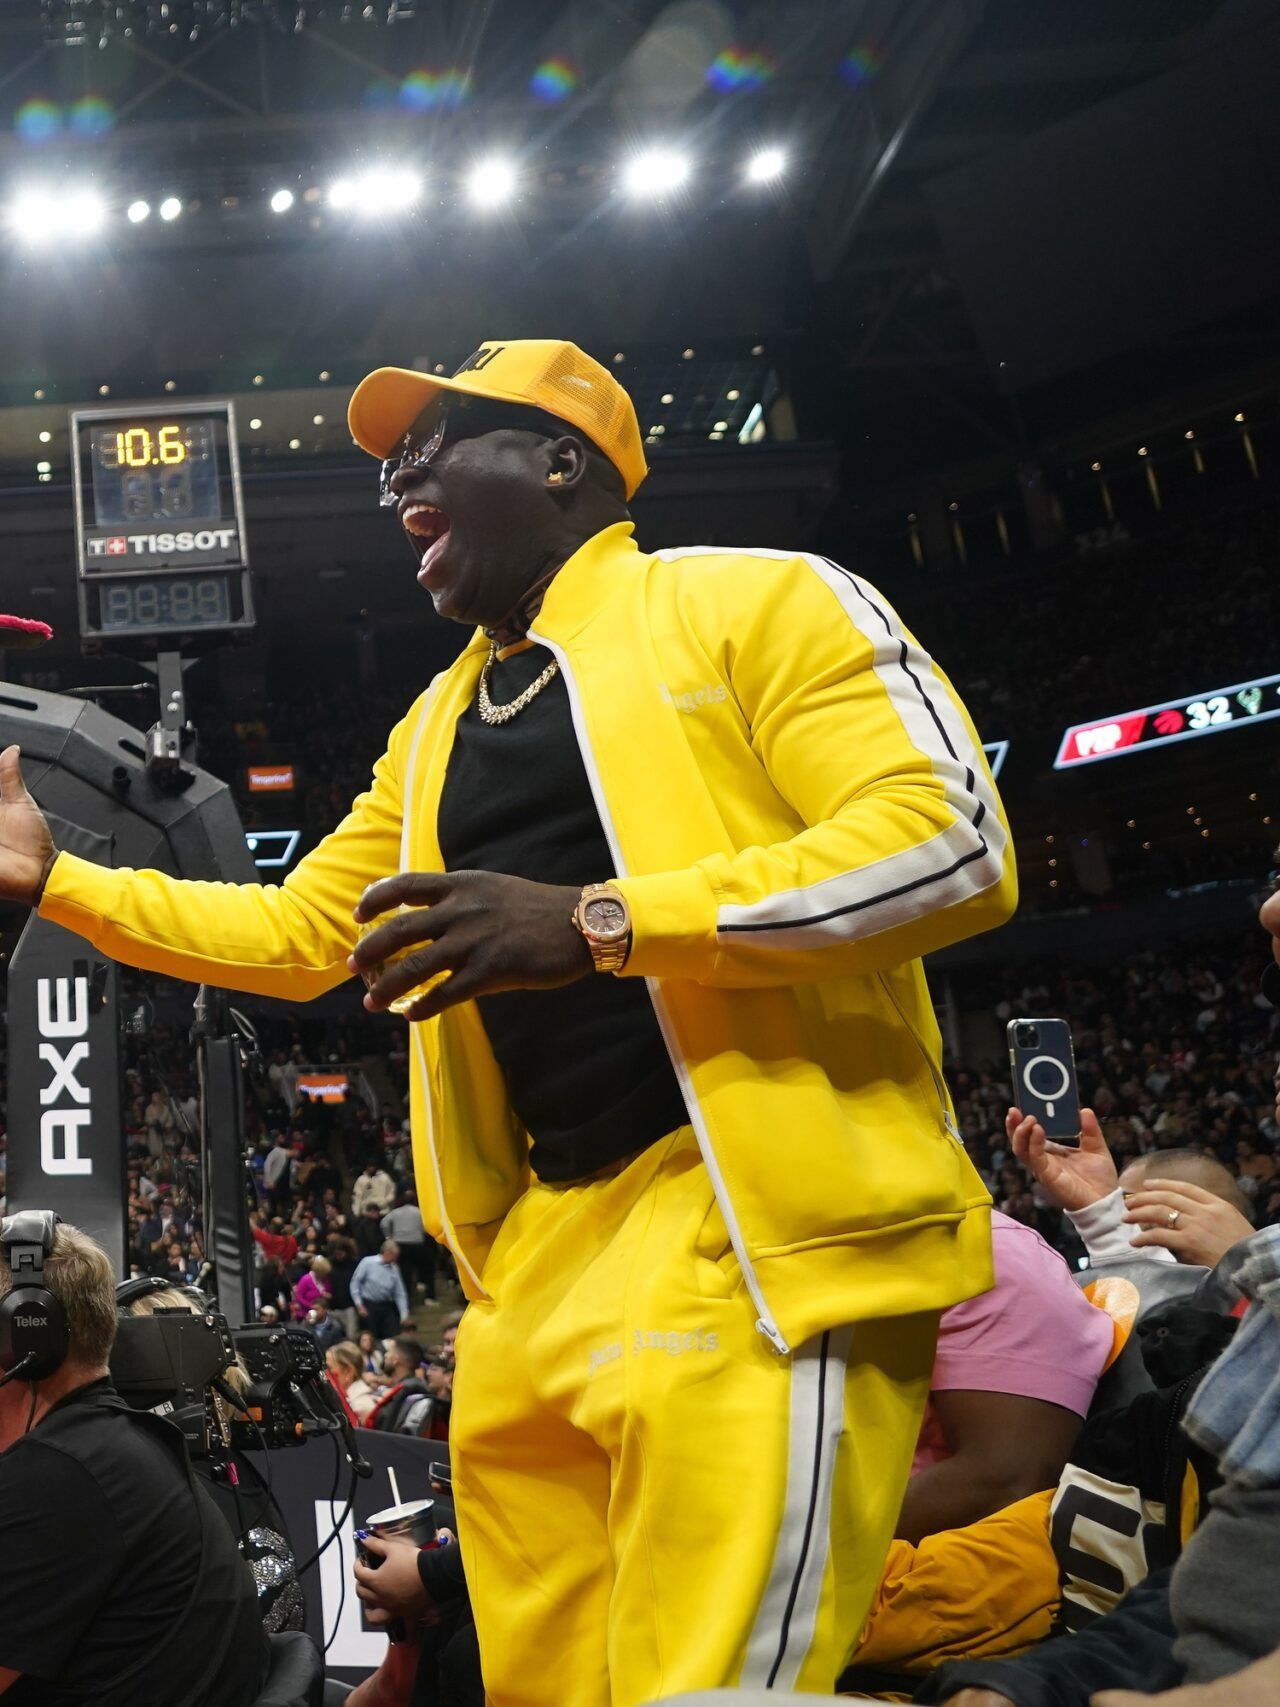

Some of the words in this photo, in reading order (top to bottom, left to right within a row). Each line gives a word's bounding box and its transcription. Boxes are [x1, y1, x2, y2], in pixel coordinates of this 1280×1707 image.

[116, 426, 186, 467] 10.6
[128, 529, 235, 554] TISSOT
[1186, 697, 1232, 729] 32
[37, 976, 93, 1176] AXE
[13, 1315, 48, 1328] Telex
[634, 1328, 719, 1358] Angels
[162, 1402, 173, 1414] B
